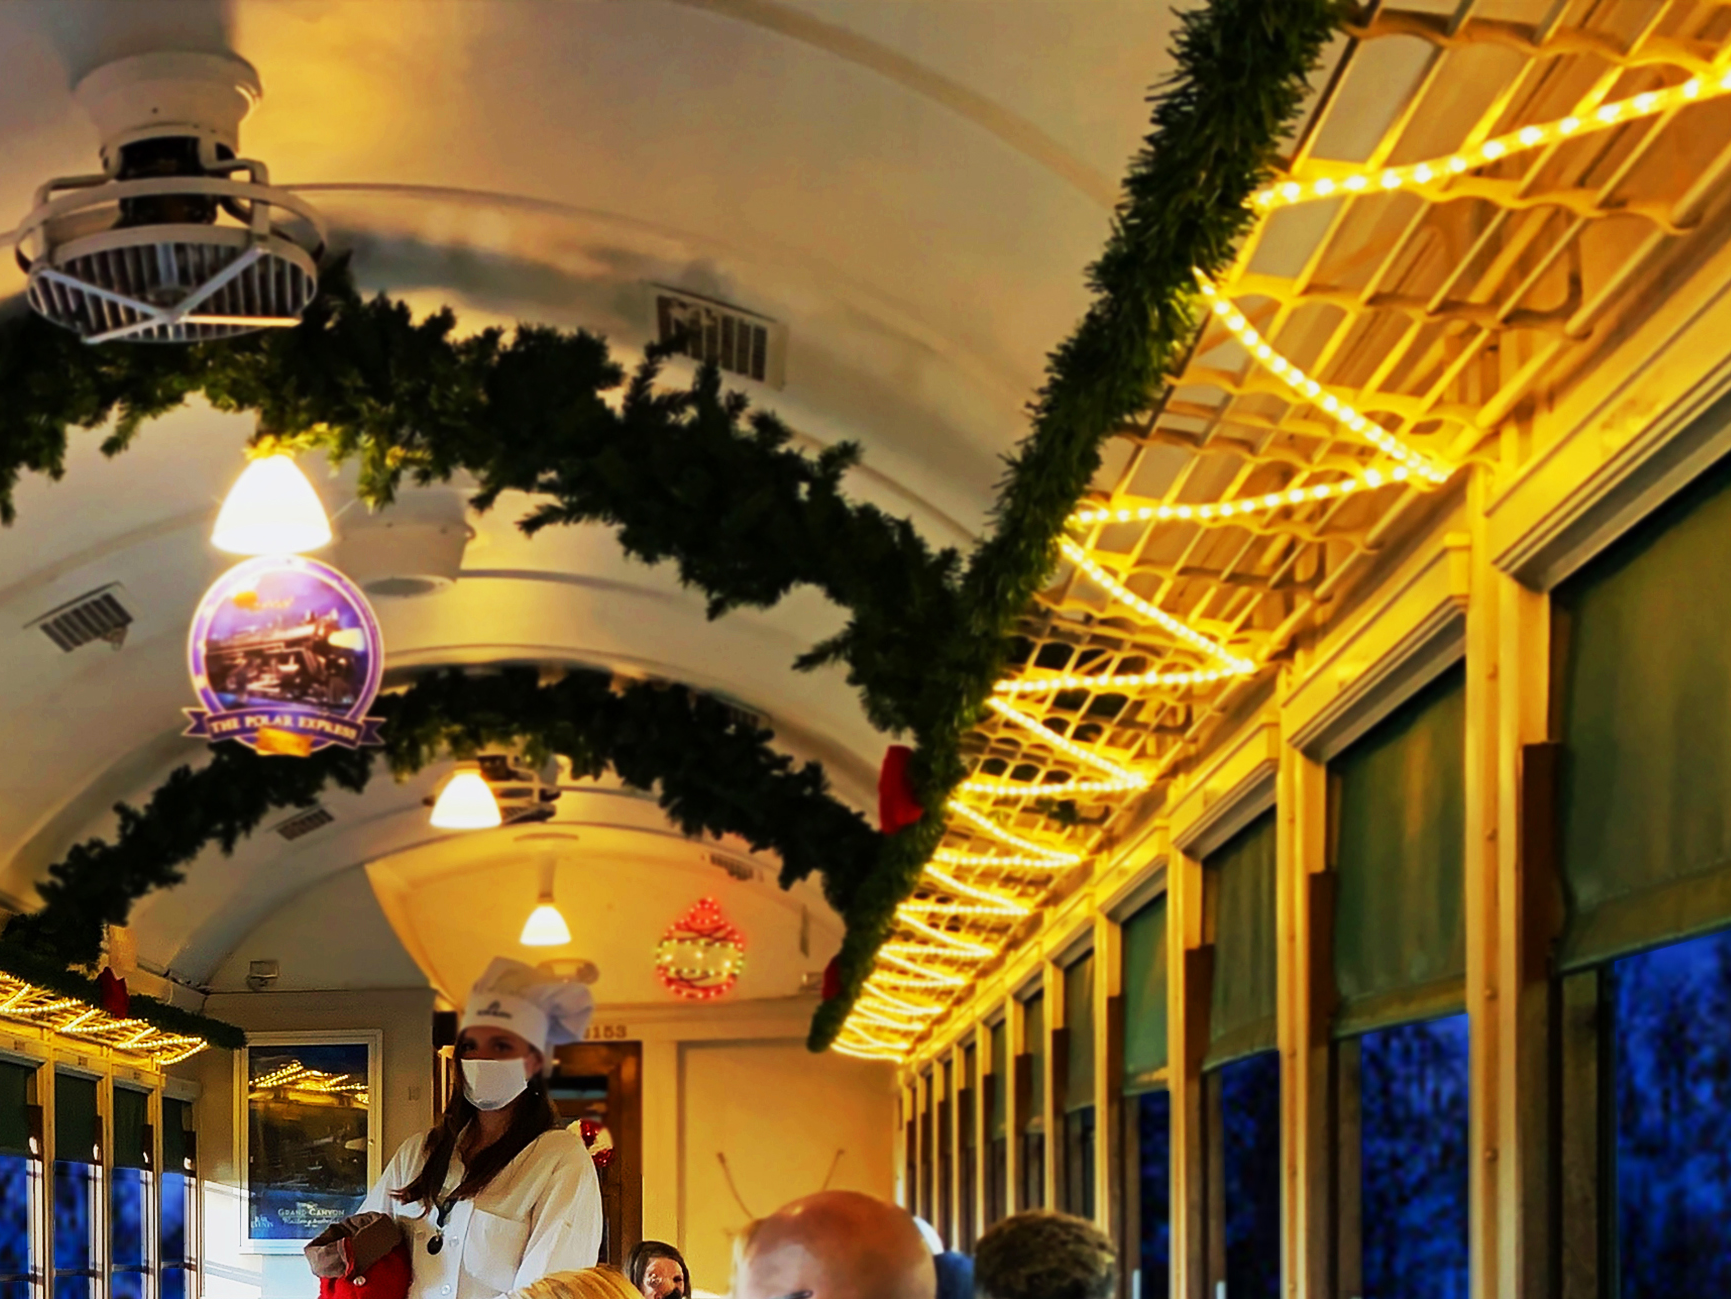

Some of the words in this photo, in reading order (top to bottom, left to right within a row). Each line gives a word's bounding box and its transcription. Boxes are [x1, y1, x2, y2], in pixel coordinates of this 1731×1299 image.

[210, 716, 240, 734] THE
[244, 714, 293, 727] POLAR
[297, 715, 358, 740] EXPRESS
[308, 1208, 345, 1217] CANYON
